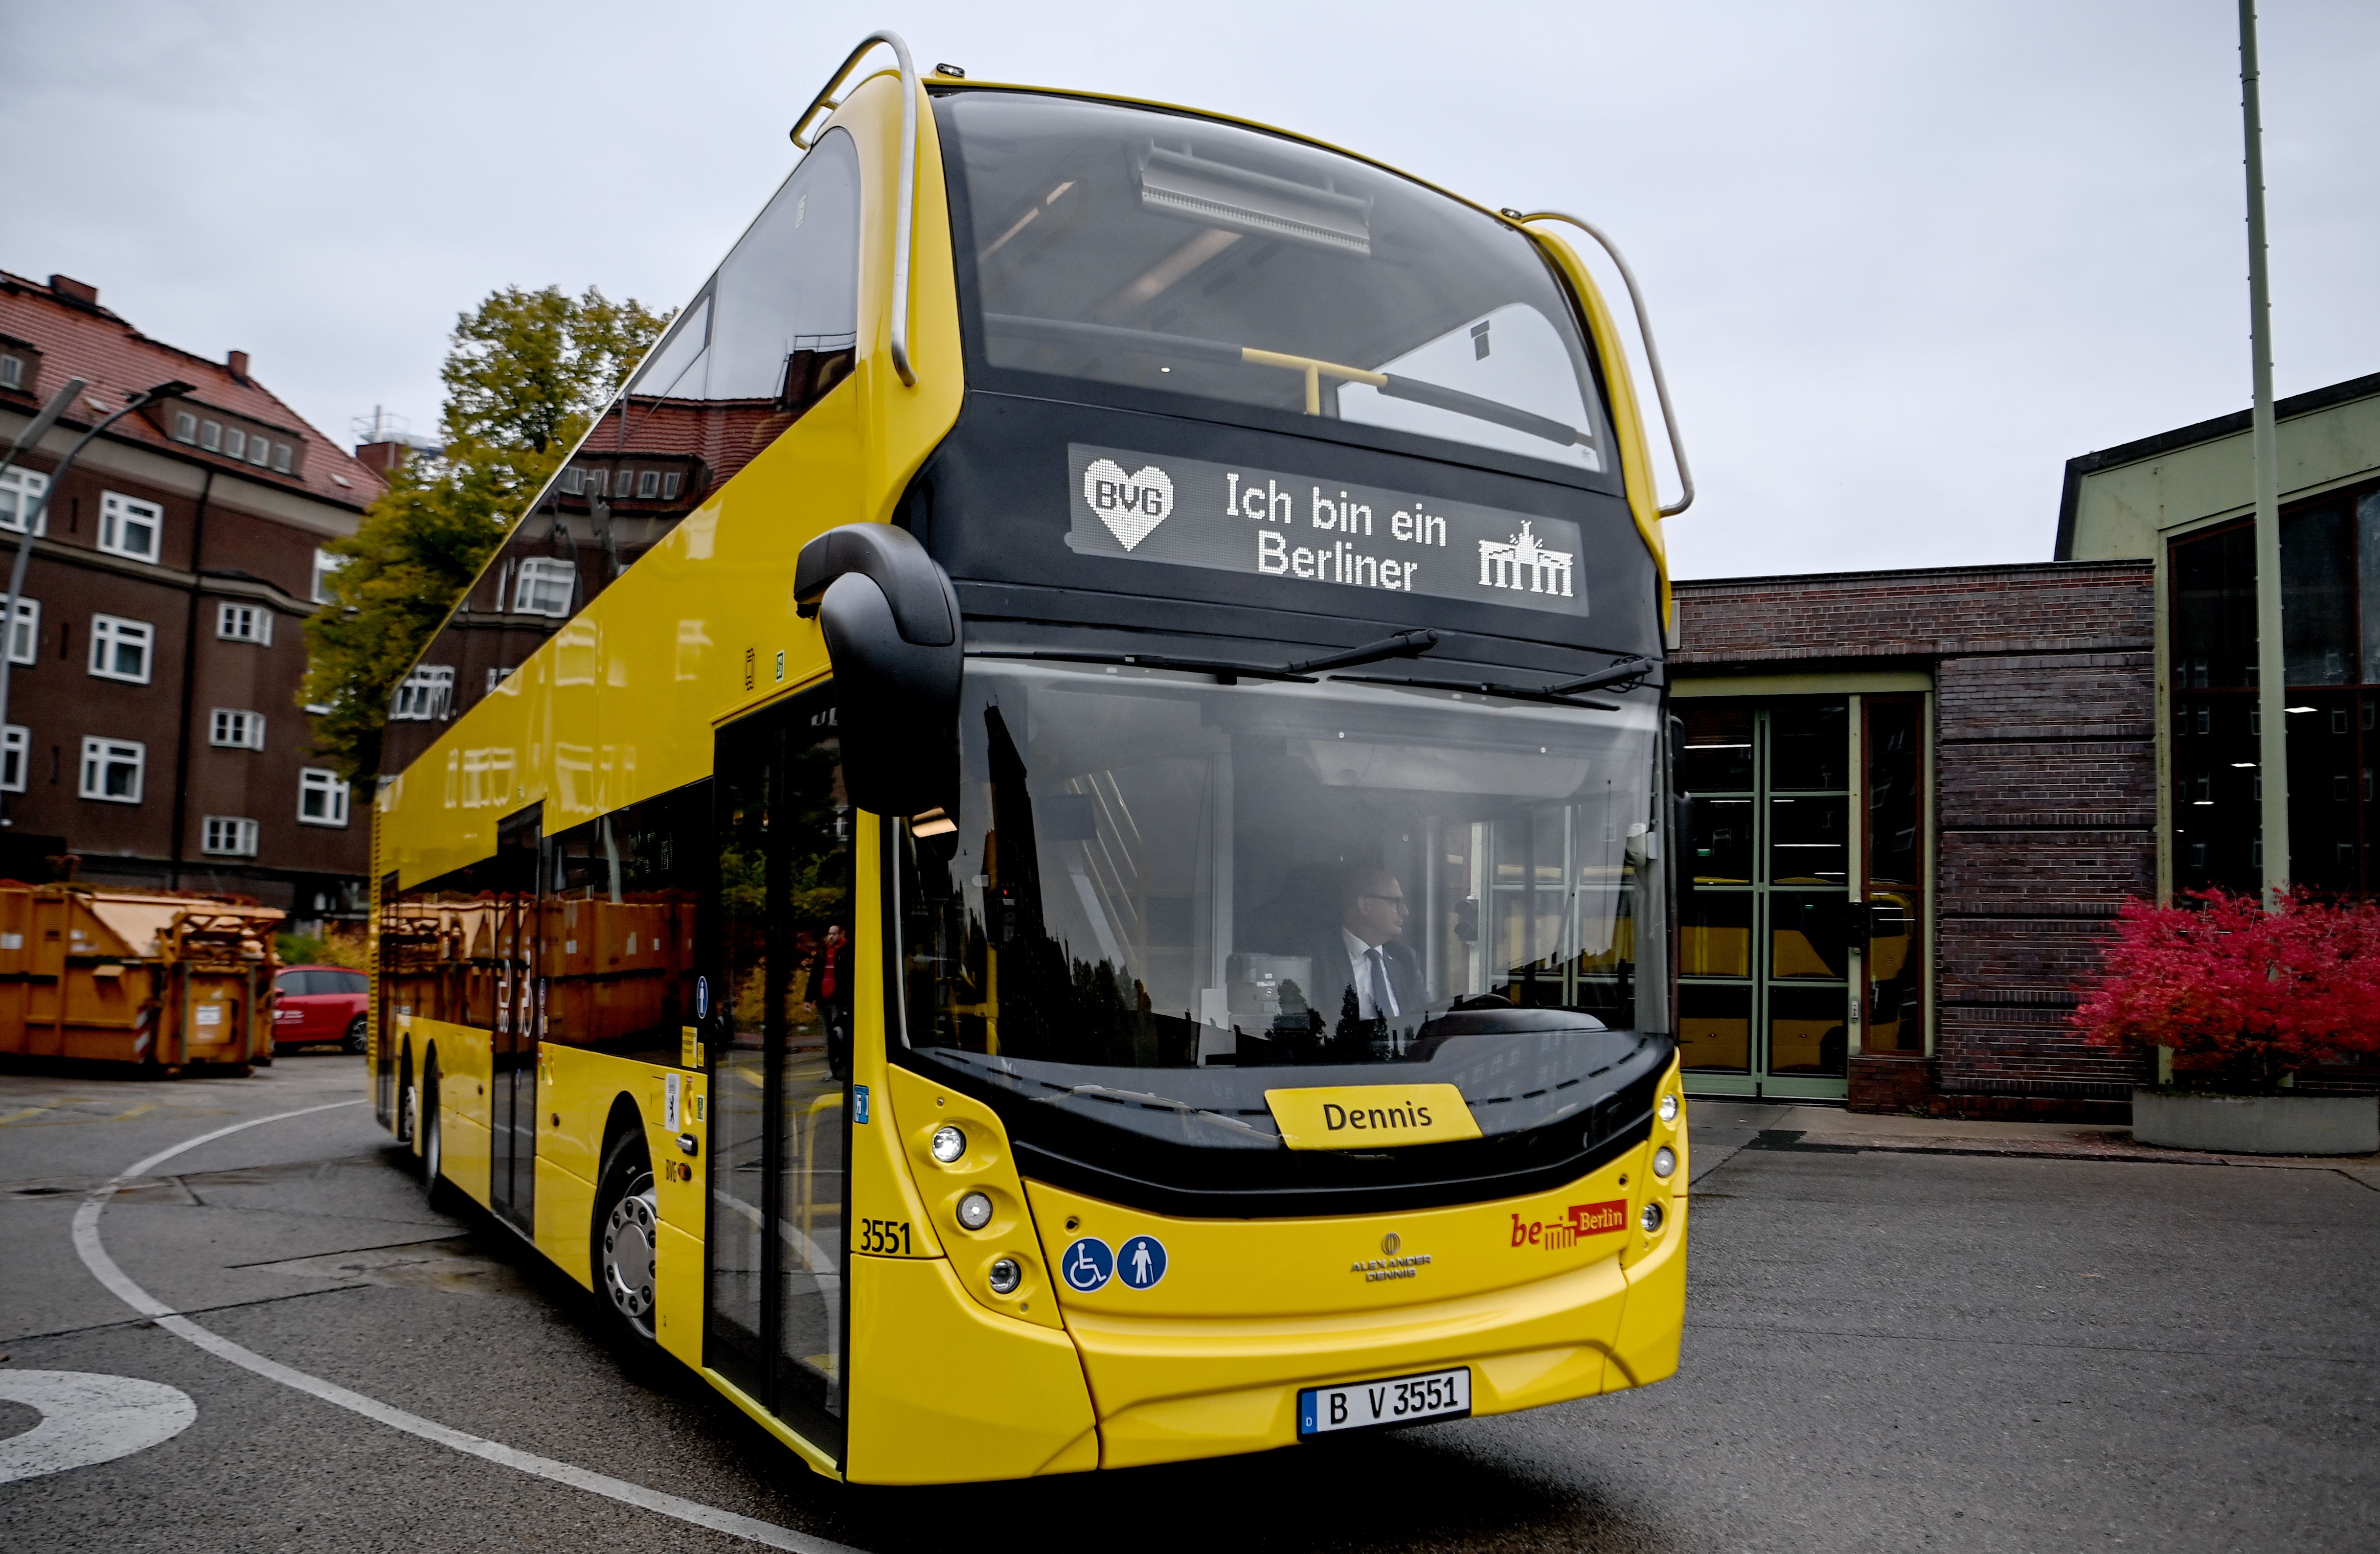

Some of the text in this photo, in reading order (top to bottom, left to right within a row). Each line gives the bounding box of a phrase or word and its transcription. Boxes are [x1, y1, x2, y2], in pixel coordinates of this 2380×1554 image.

[1097, 480, 1162, 515] BVG
[1227, 473, 1446, 547] Ich bin ein
[1258, 530, 1418, 591] Berliner
[1323, 1100, 1432, 1131] Dennis
[666, 1159, 677, 1183] BVG
[1580, 1208, 1623, 1231] Berlin
[861, 1218, 910, 1254] 3551
[1351, 1255, 1432, 1272] ALEXANDER
[1366, 1268, 1417, 1282] DENNIS
